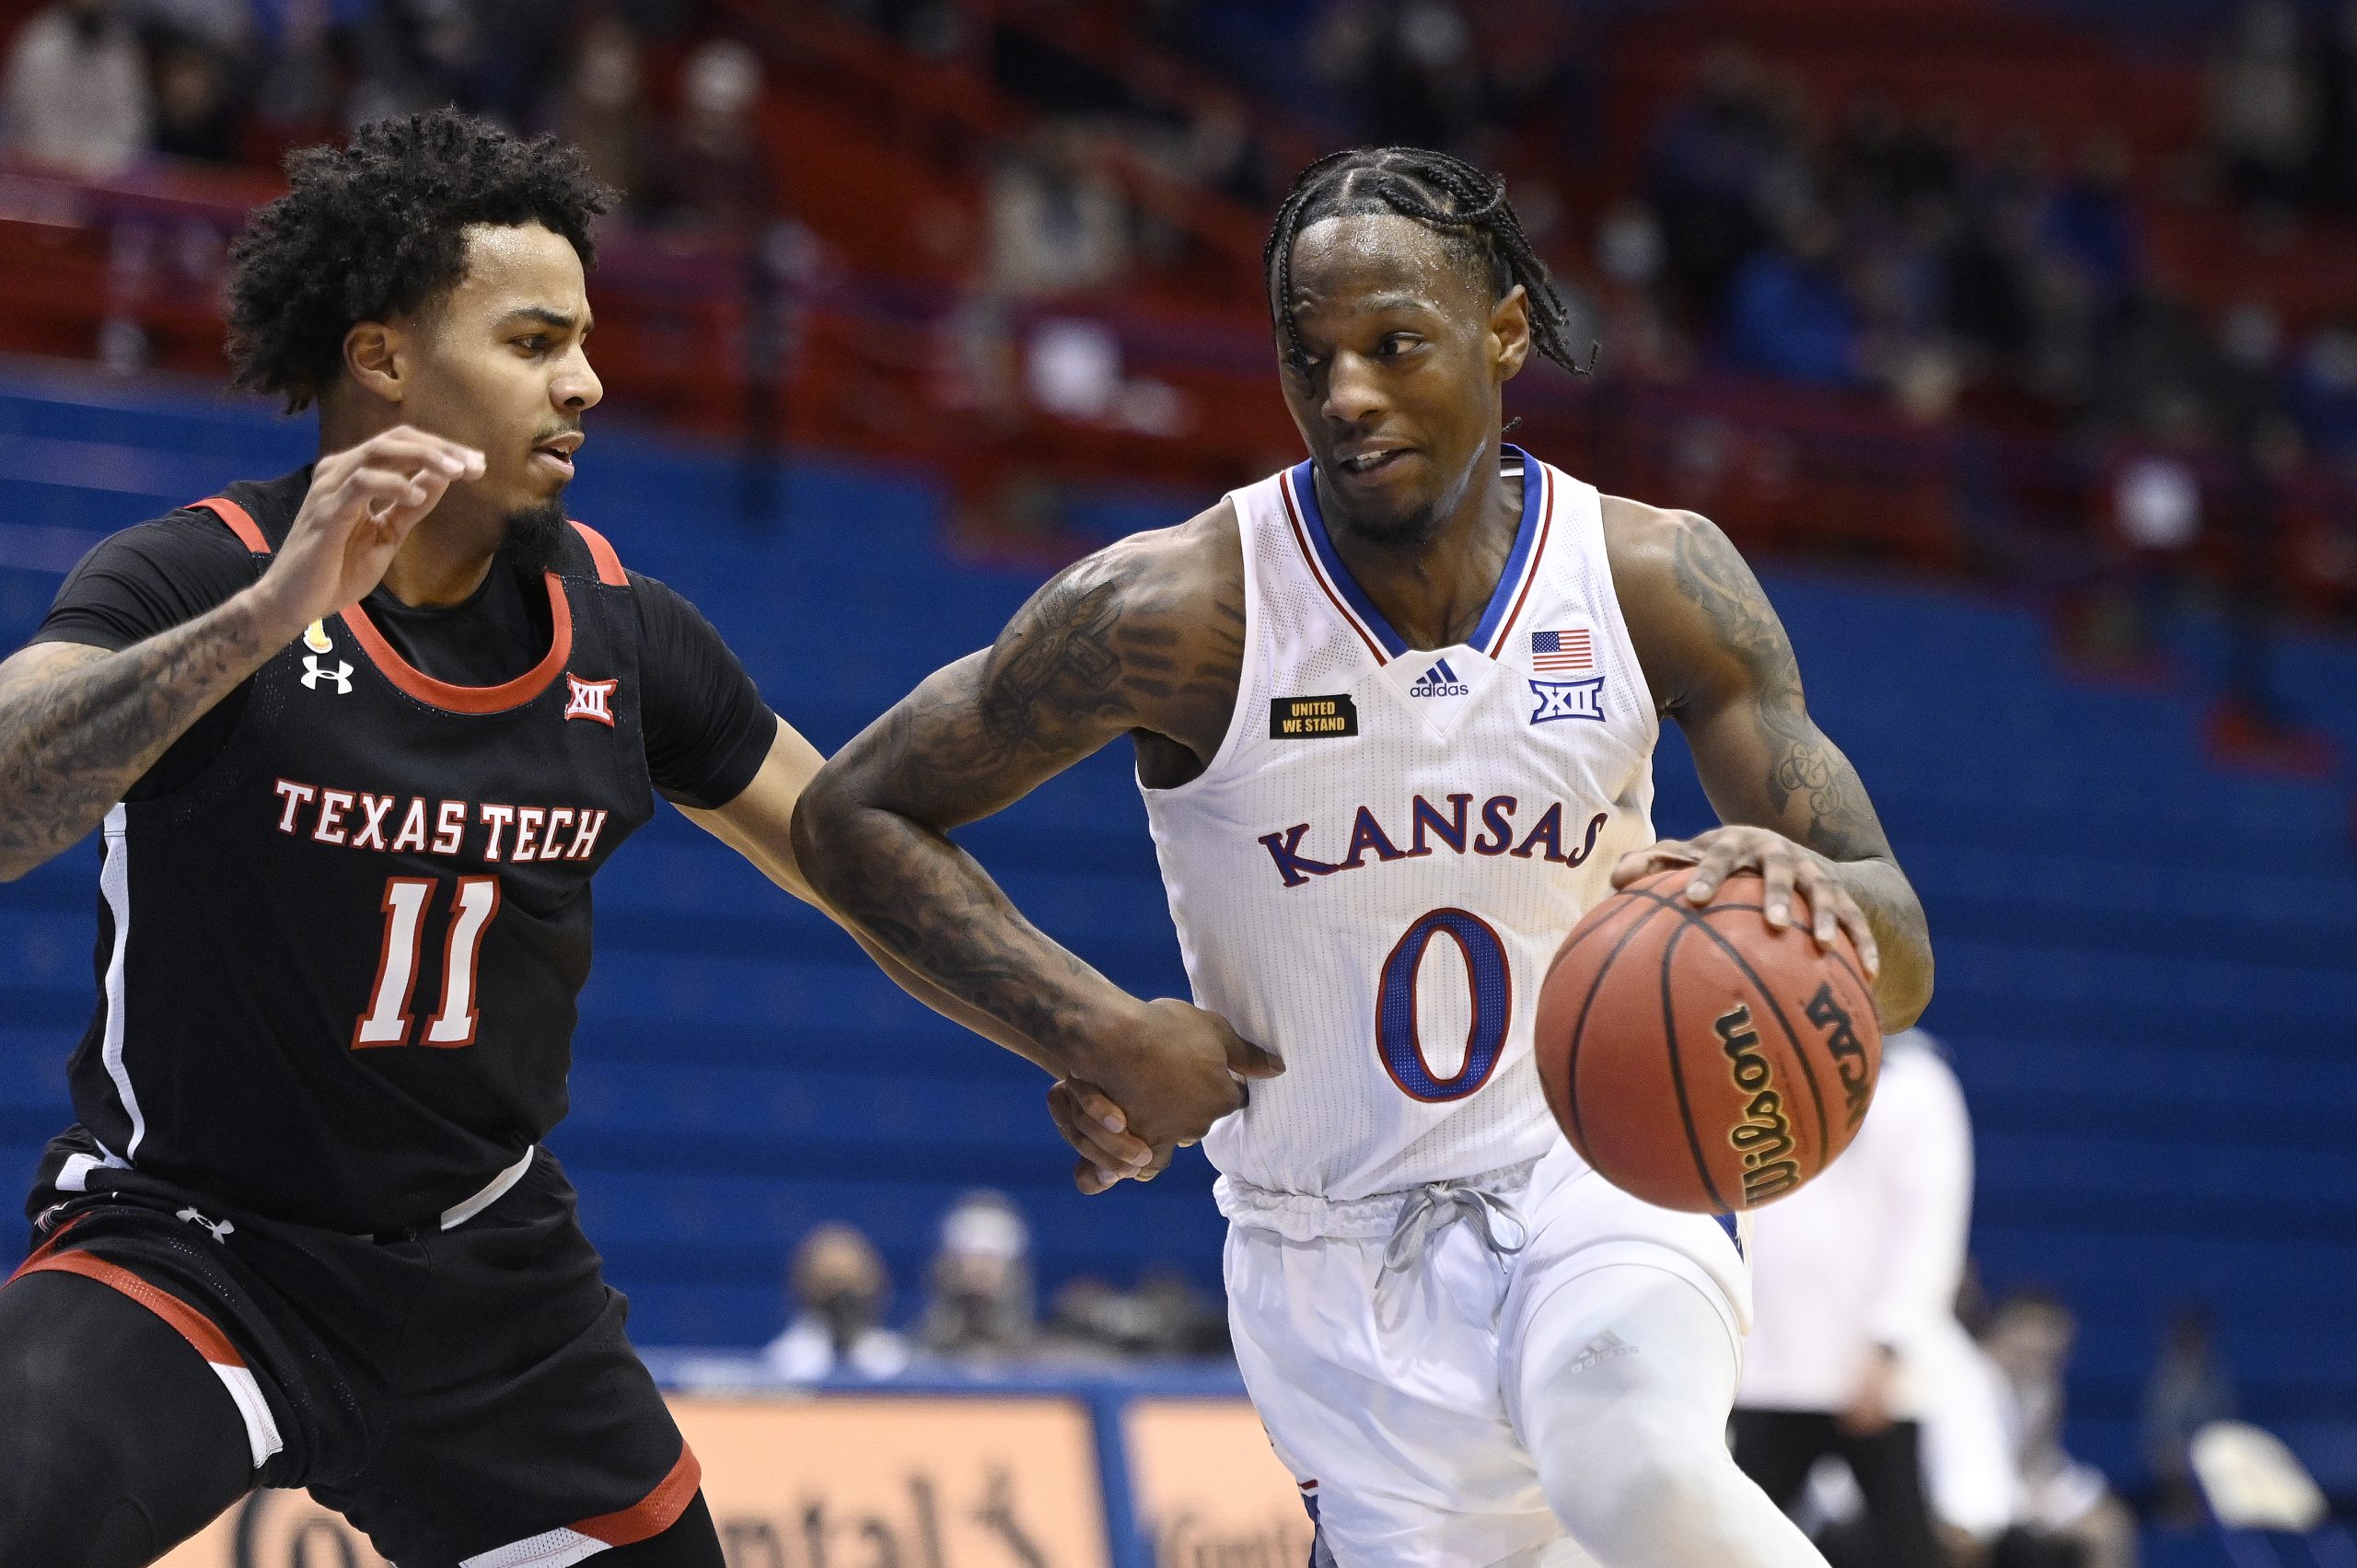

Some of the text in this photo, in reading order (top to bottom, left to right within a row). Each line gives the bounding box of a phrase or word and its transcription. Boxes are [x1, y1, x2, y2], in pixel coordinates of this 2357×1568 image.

[1282, 716, 1345, 734] WE STAND
[1291, 701, 1336, 717] UNITED
[1410, 682, 1469, 698] adidas
[273, 777, 608, 864] TEXAS TECH
[1257, 793, 1608, 888] KANSAS
[350, 875, 501, 1051] 11
[1375, 906, 1513, 1104] 0
[1805, 980, 1869, 1131] NCAA
[1713, 1003, 1801, 1208] Wilson
